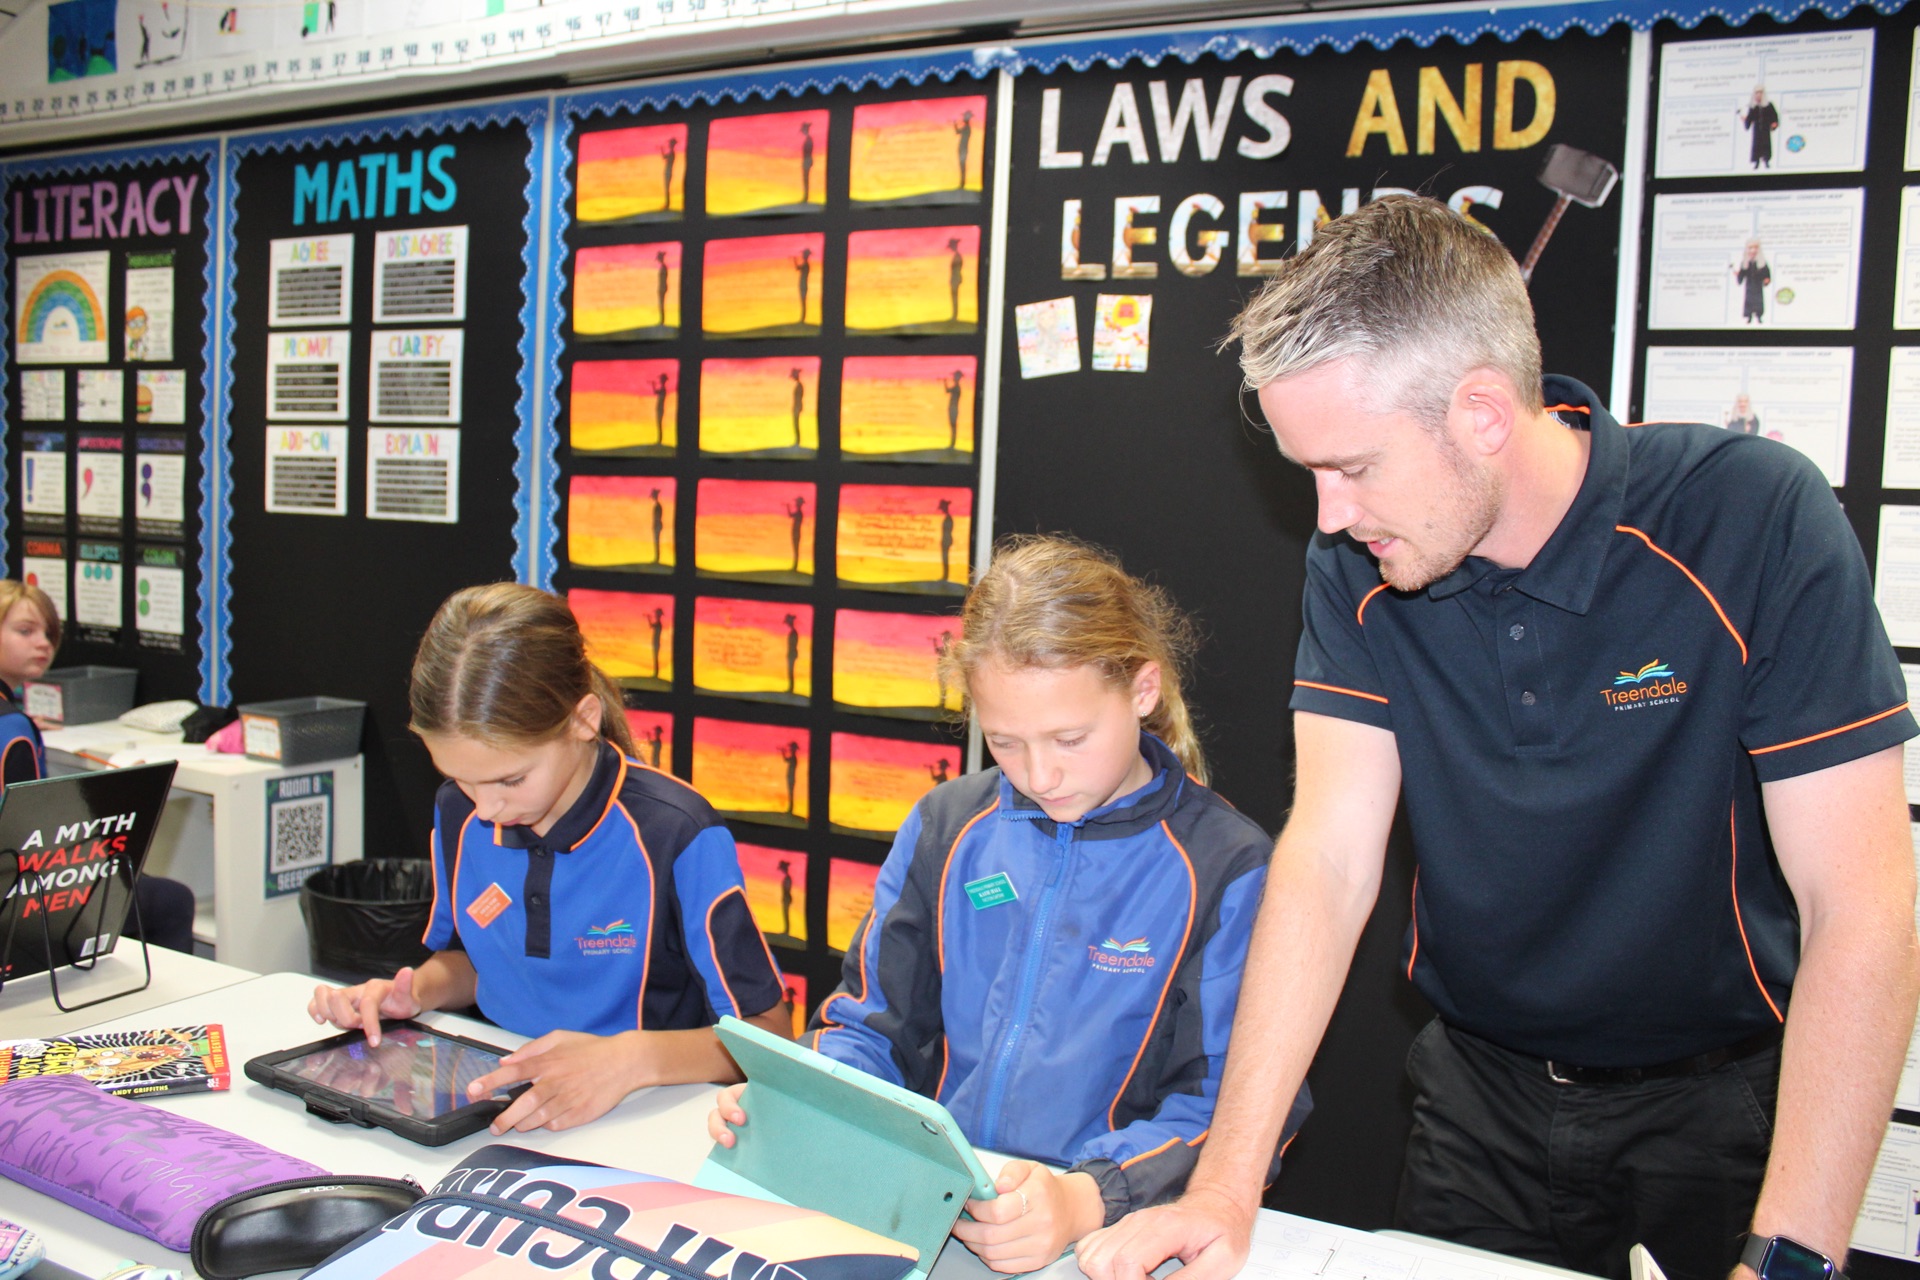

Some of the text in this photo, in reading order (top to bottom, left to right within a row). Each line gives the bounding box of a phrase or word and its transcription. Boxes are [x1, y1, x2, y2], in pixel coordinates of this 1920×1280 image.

[51, 96, 62, 110] 23
[68, 95, 79, 108] 24
[87, 91, 97, 105] 25
[106, 88, 117, 103] 26
[124, 85, 135, 99] 27
[143, 82, 155, 95] 28
[163, 80, 175, 93] 29
[203, 73, 213, 86] 31
[223, 69, 234, 81] 32
[244, 65, 255, 78] 33
[266, 61, 277, 74] 34
[289, 59, 300, 72] 35
[311, 56, 321, 70] 36
[333, 53, 346, 66] 37
[357, 50, 369, 64] 38
[381, 47, 392, 61] 39
[404, 43, 418, 56] 40
[432, 41, 443, 55] 41
[455, 39, 468, 53] 42
[481, 32, 495, 46] 43
[508, 28, 524, 42] 44
[536, 24, 551, 37] 45
[565, 16, 581, 31] 46
[595, 12, 612, 26] 47
[624, 6, 640, 21] 48
[657, 0, 674, 13] 49
[688, 0, 706, 11] 50
[1039, 60, 1556, 169] LAWS AND
[293, 144, 457, 225] MATHS
[14, 174, 198, 243] LITERACY
[388, 232, 453, 258] DISAGREE
[1061, 186, 1503, 281] LEGENS
[290, 240, 329, 262] AGREE
[284, 336, 333, 358] PROMPT
[389, 335, 444, 357] CLARIFY
[281, 432, 329, 451] ADD-ON
[385, 434, 438, 455] EXPLAIN
[1600, 677, 1687, 706] Treendale
[1615, 697, 1680, 711] PRIMARY SCHOOL
[279, 777, 310, 799] ROOM
[21, 812, 137, 850] A MYTH
[18, 835, 128, 872] WALKS
[6, 859, 120, 899] AMONG
[277, 865, 320, 891] SEESA
[22, 886, 92, 919] MEN
[1087, 945, 1155, 967] Treendale
[1091, 963, 1120, 973] PRIMARY
[209, 1031, 225, 1068] TERRY DENTON
[112, 1084, 169, 1096] ANDY GRIFFITHS
[298, 1185, 344, 1195] VOGUE
